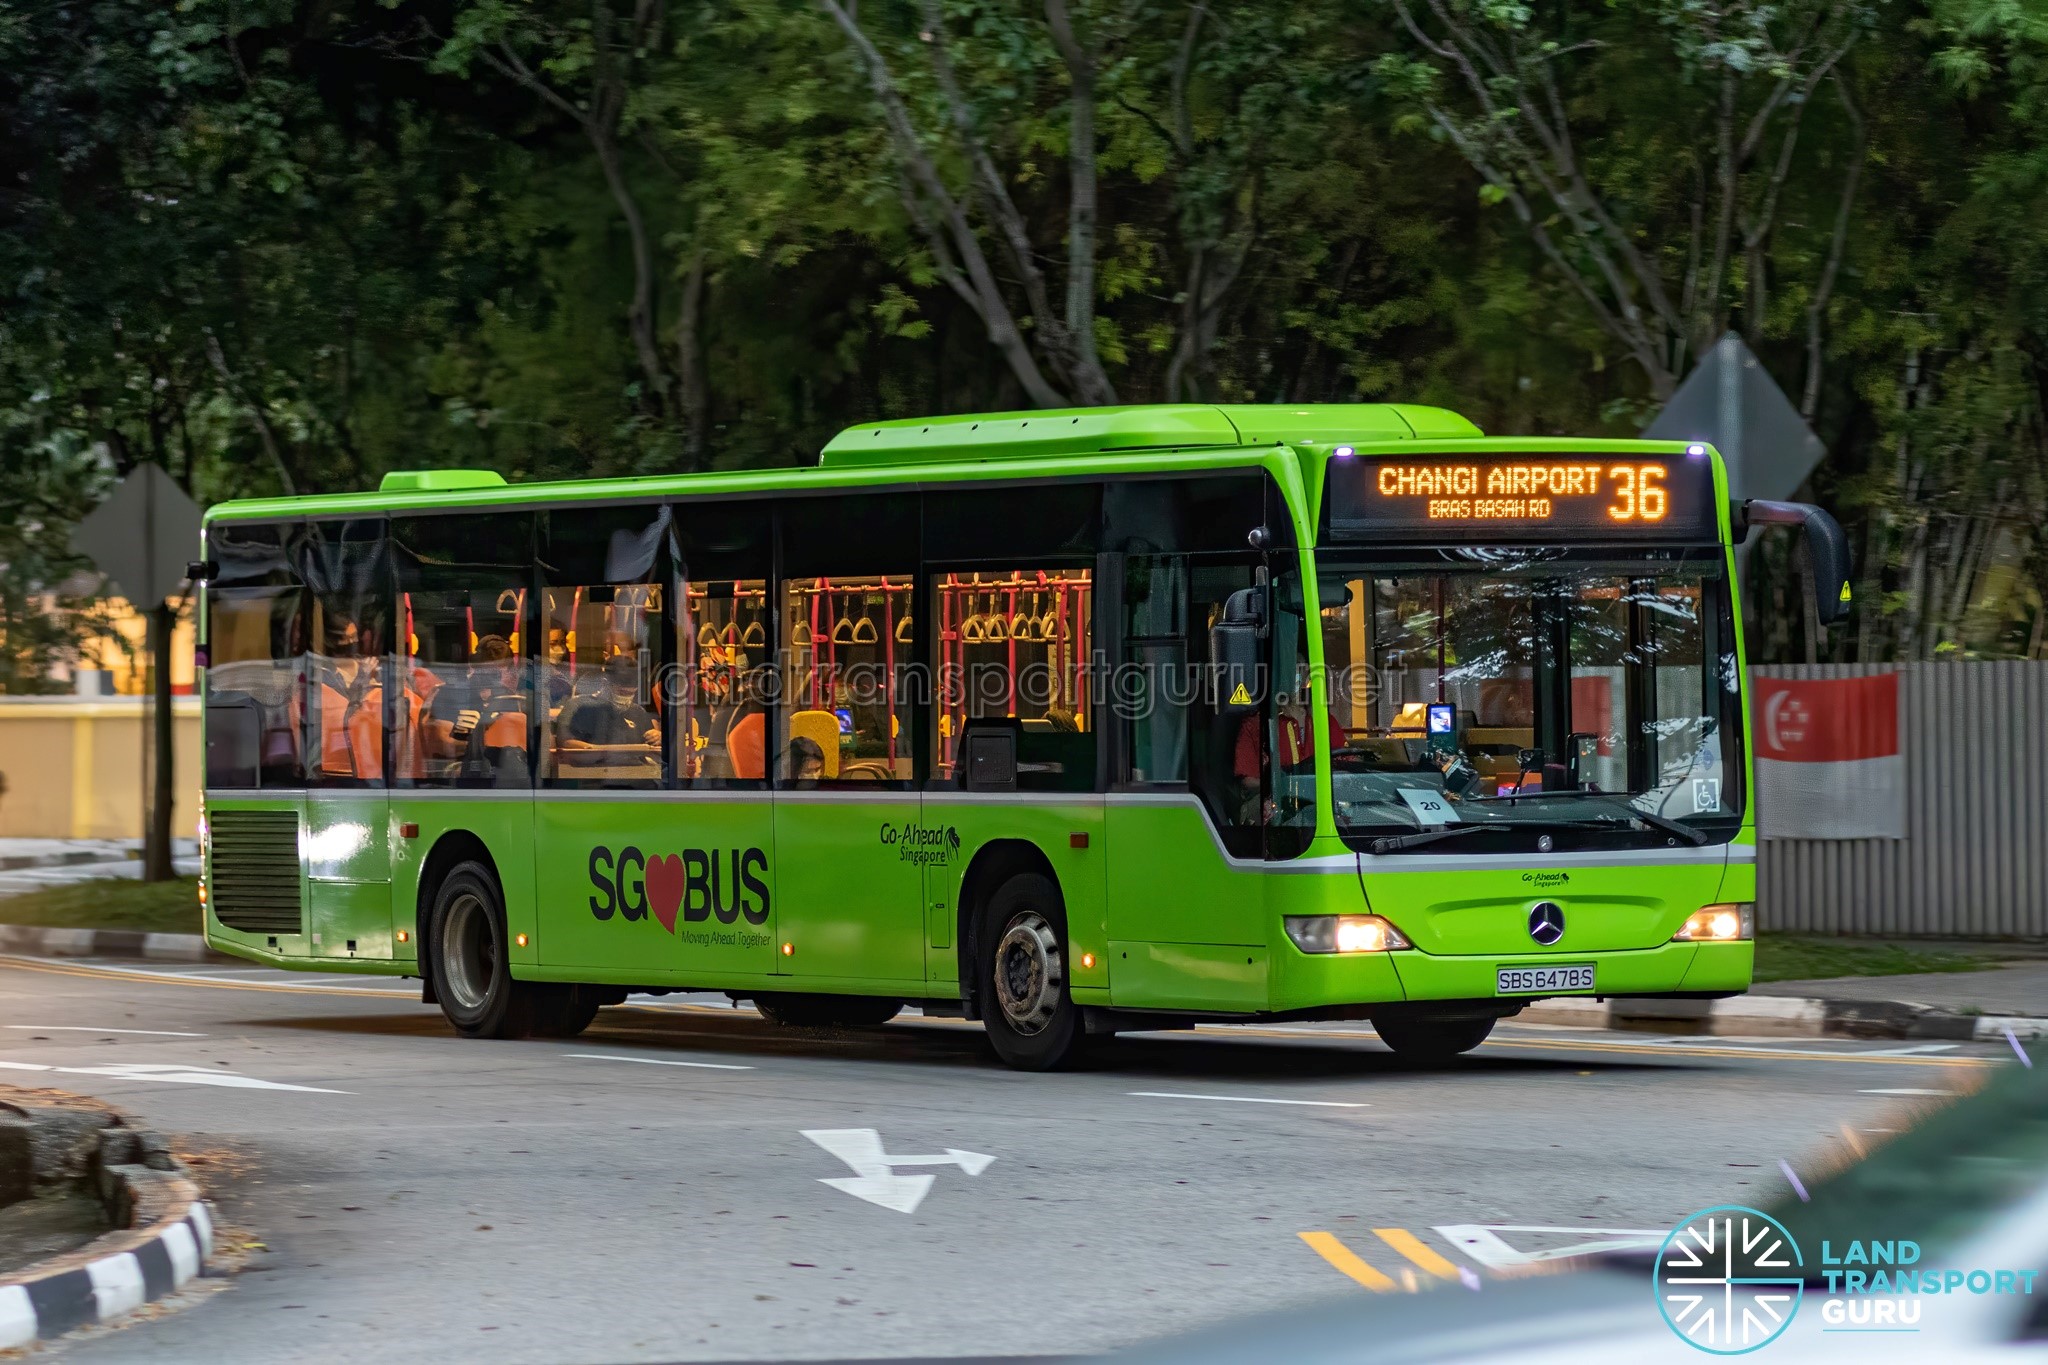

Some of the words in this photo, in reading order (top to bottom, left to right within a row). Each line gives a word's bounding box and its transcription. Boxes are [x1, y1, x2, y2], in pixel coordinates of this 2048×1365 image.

[1378, 466, 1478, 495] CHANGI
[1487, 466, 1602, 495] AIRPORT
[1607, 465, 1667, 520] 36
[1428, 500, 1471, 518] BRAS
[1474, 500, 1525, 518] BASAH
[1528, 500, 1551, 518] RD
[1420, 801, 1442, 811] 20
[880, 823, 944, 845] Go-Ahead
[900, 846, 946, 866] Singapore
[1521, 873, 1561, 882] Go-Ahead
[681, 931, 709, 947] Moving
[711, 931, 736, 945] Ahead
[737, 931, 771, 948] Together
[1500, 969, 1592, 989] SBS6478S
